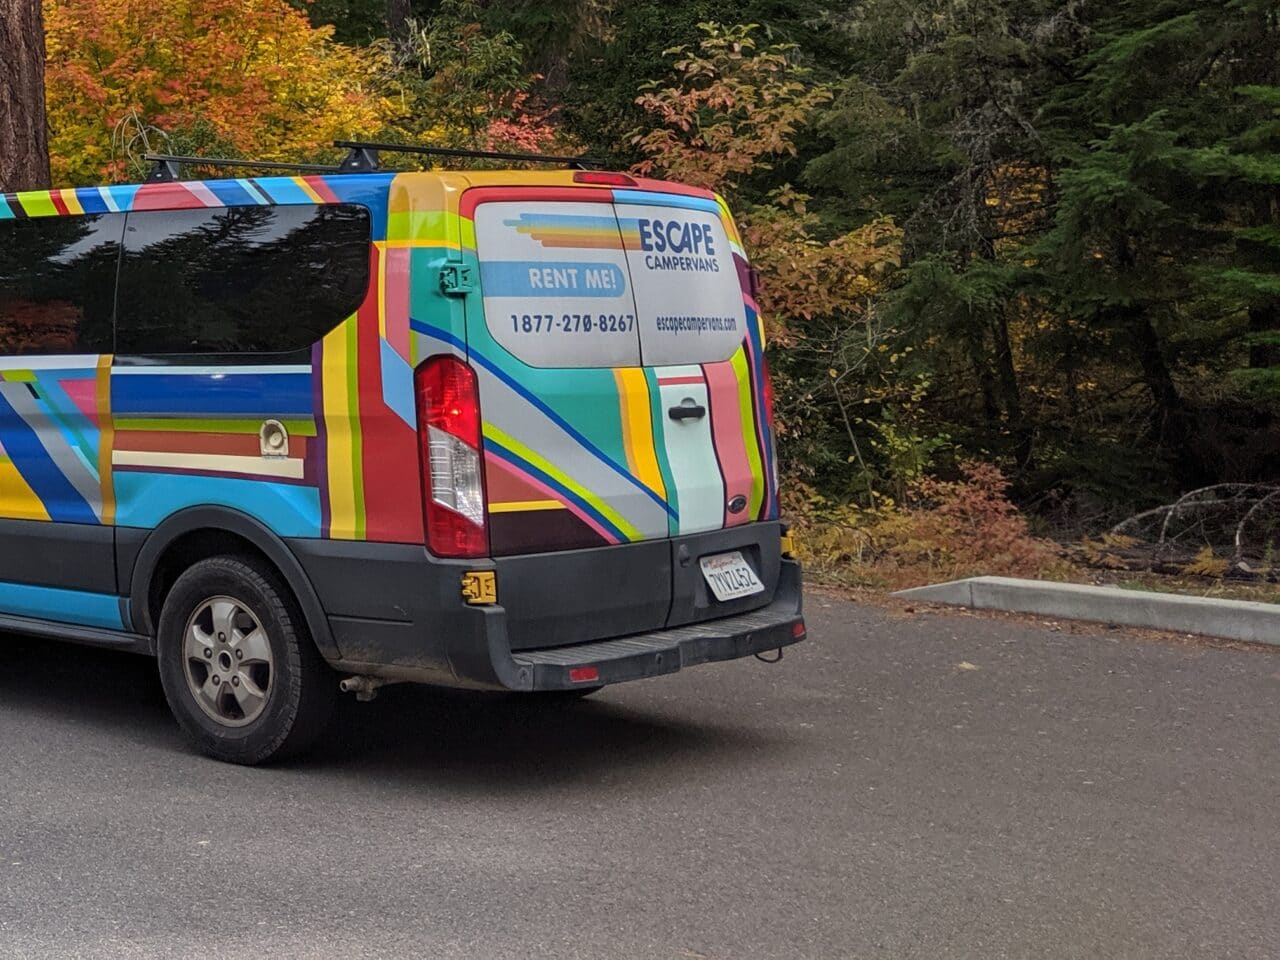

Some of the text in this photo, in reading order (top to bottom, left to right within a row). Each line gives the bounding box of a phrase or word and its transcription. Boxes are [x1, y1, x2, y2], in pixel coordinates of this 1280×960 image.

[638, 218, 715, 256] ESCAPE
[645, 255, 720, 273] CAMPERVANS
[528, 268, 617, 289] RENT ME!
[656, 316, 737, 336] escapecampervans.com
[708, 567, 757, 593] 7YVZ452
